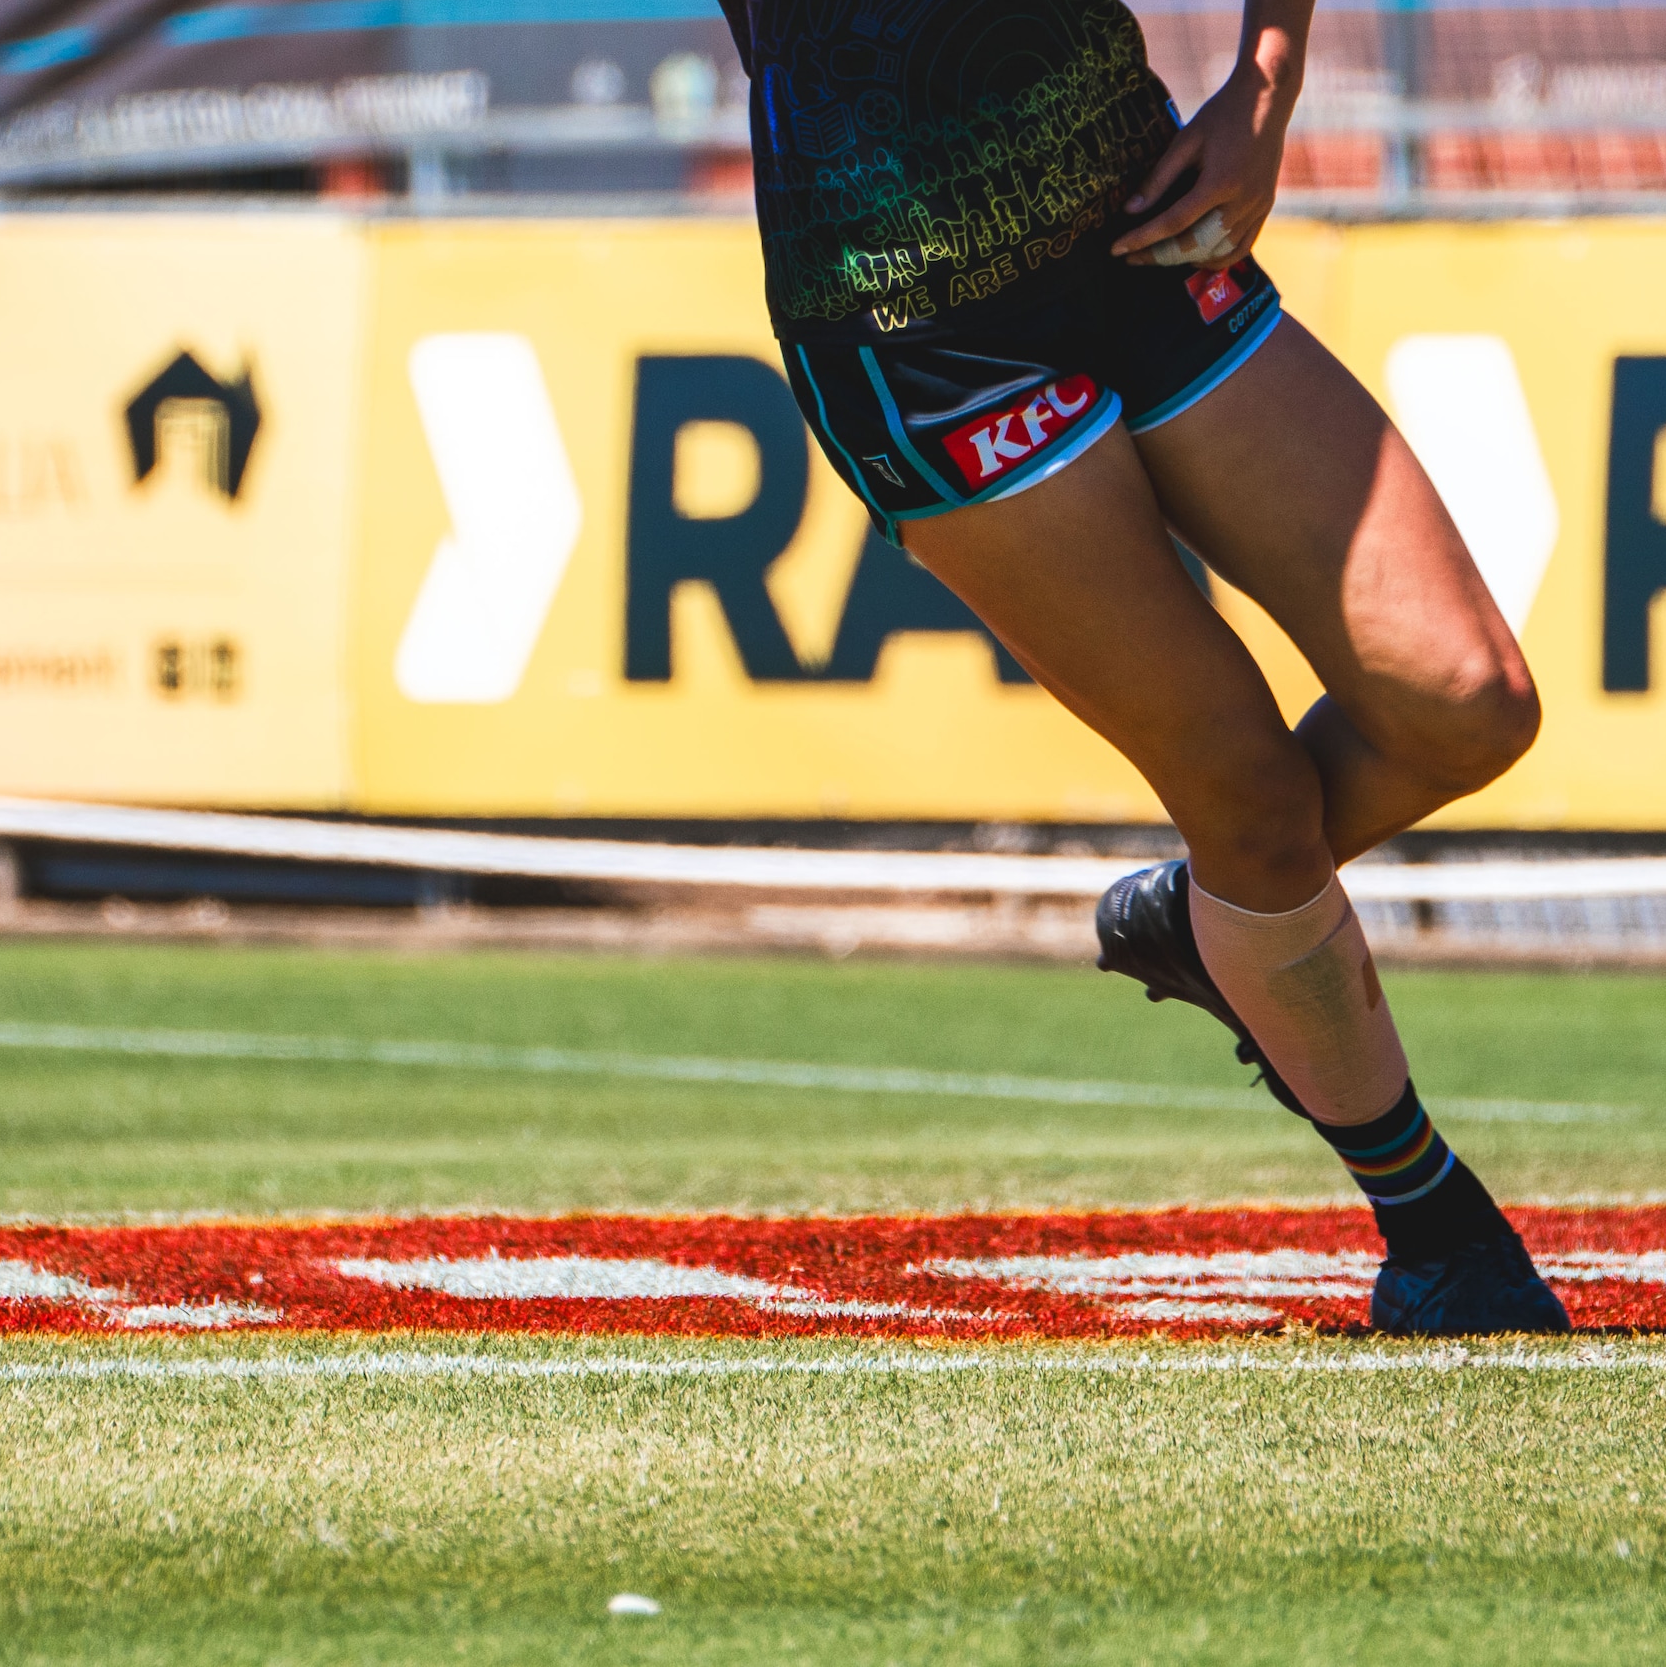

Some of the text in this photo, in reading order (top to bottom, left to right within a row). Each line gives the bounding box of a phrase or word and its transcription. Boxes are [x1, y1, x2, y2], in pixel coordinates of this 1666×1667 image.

[872, 287, 936, 332] WE
[950, 252, 1019, 307] ARE
[969, 383, 1089, 477] KFC
